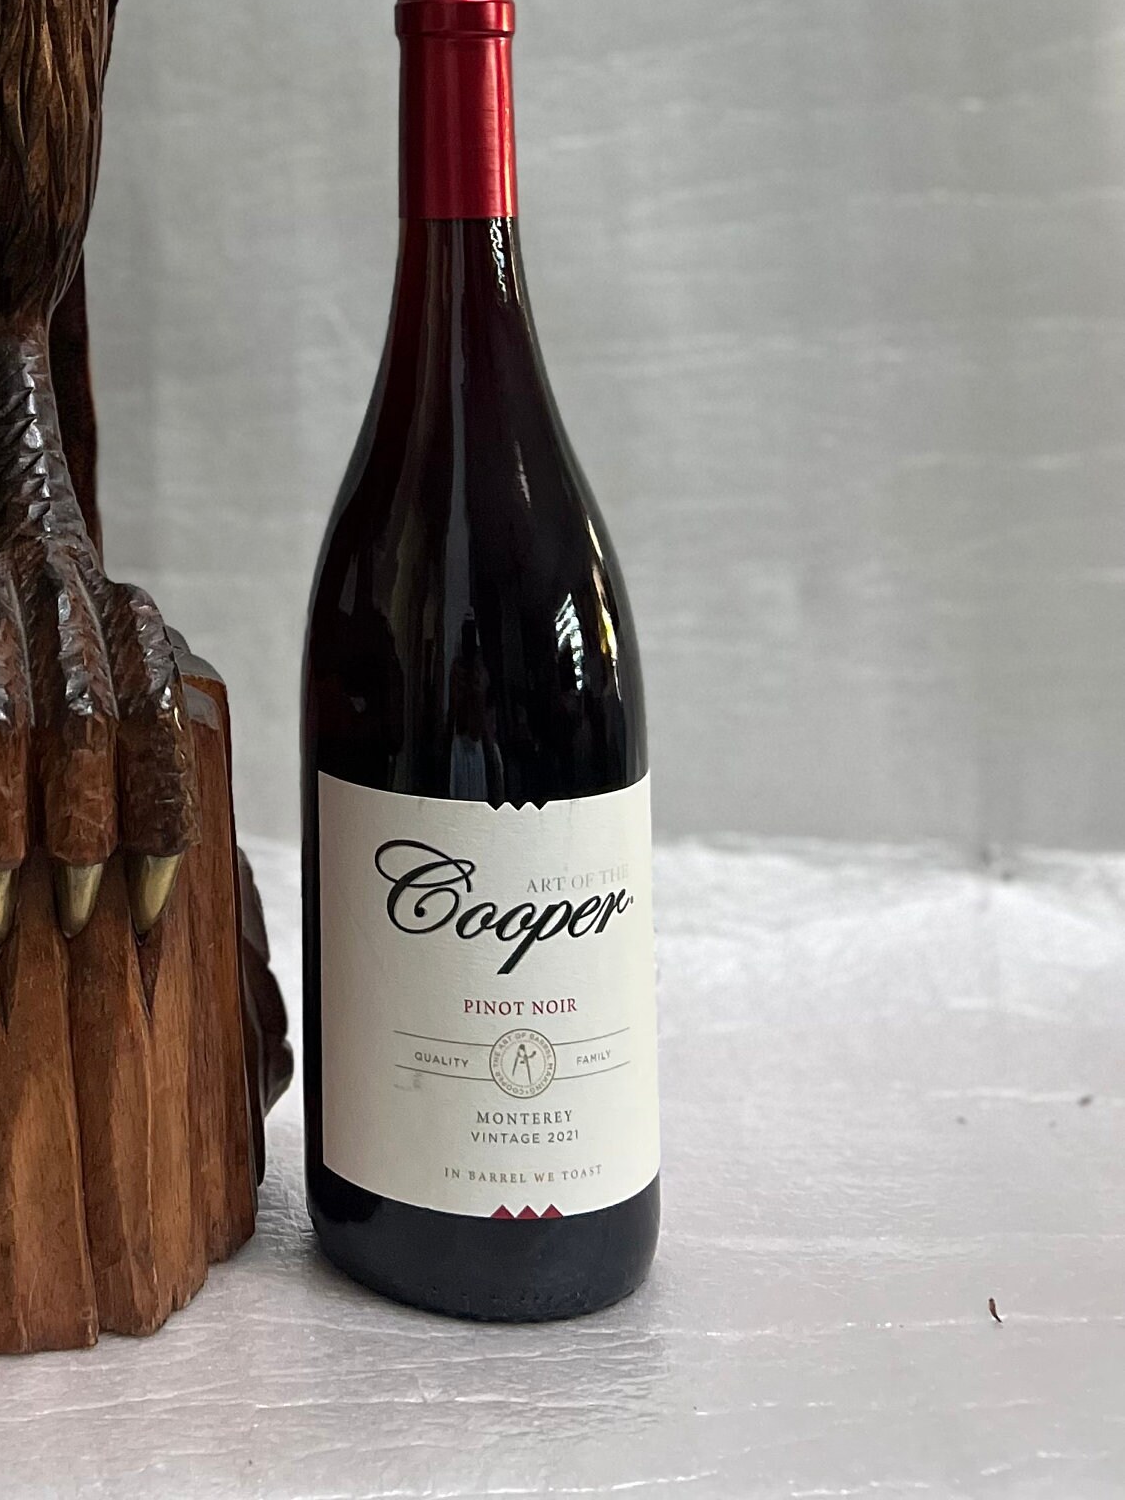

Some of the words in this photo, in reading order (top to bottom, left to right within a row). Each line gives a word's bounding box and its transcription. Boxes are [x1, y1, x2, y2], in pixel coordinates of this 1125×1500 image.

[526, 876, 566, 893] ART
[572, 874, 593, 889] OF
[599, 864, 629, 885] THE
[375, 839, 630, 975] Cooper
[463, 999, 524, 1016] PINOT
[532, 998, 577, 1015] NOIR
[414, 1051, 469, 1068] QUALITY
[576, 1049, 612, 1066] FAMILY
[476, 1110, 572, 1125] MONTEREY
[471, 1131, 541, 1144] VINTAGE
[547, 1129, 579, 1143] 2021
[444, 1167, 461, 1179] IN
[468, 1171, 527, 1184] BARREL
[534, 1172, 555, 1184] WE
[561, 1164, 602, 1181] TOAST
